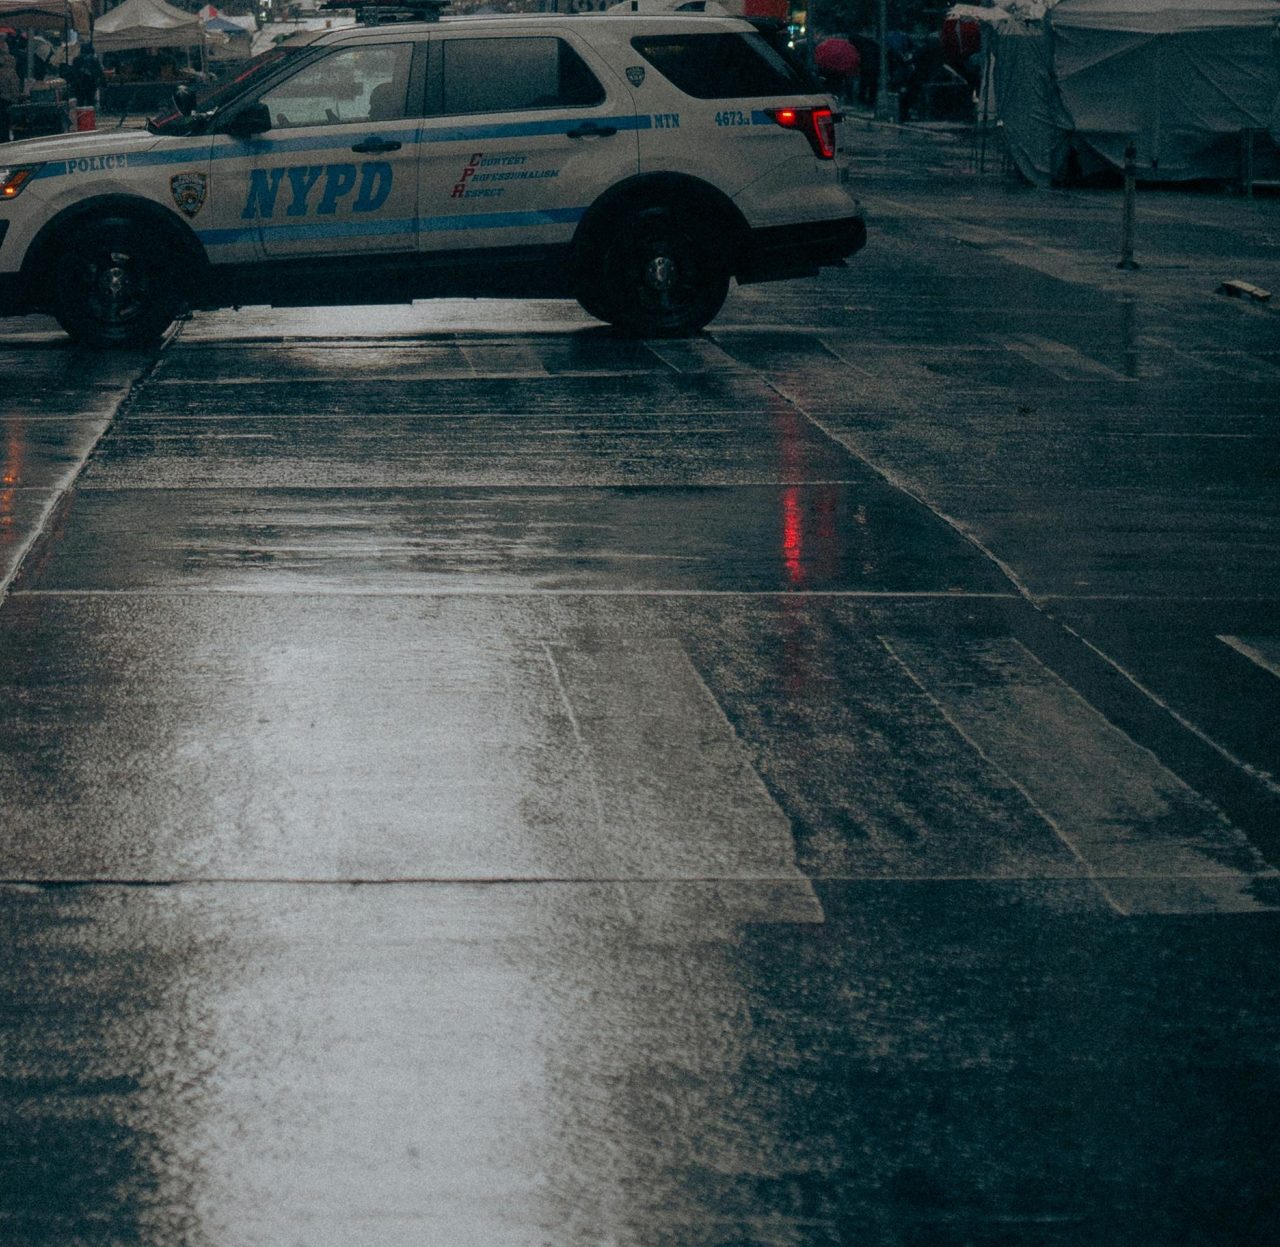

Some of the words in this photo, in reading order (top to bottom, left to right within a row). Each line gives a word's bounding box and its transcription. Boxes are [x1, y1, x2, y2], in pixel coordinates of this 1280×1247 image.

[715, 111, 744, 127] 4673
[66, 153, 127, 174] POLICE
[241, 161, 394, 219] NYPD
